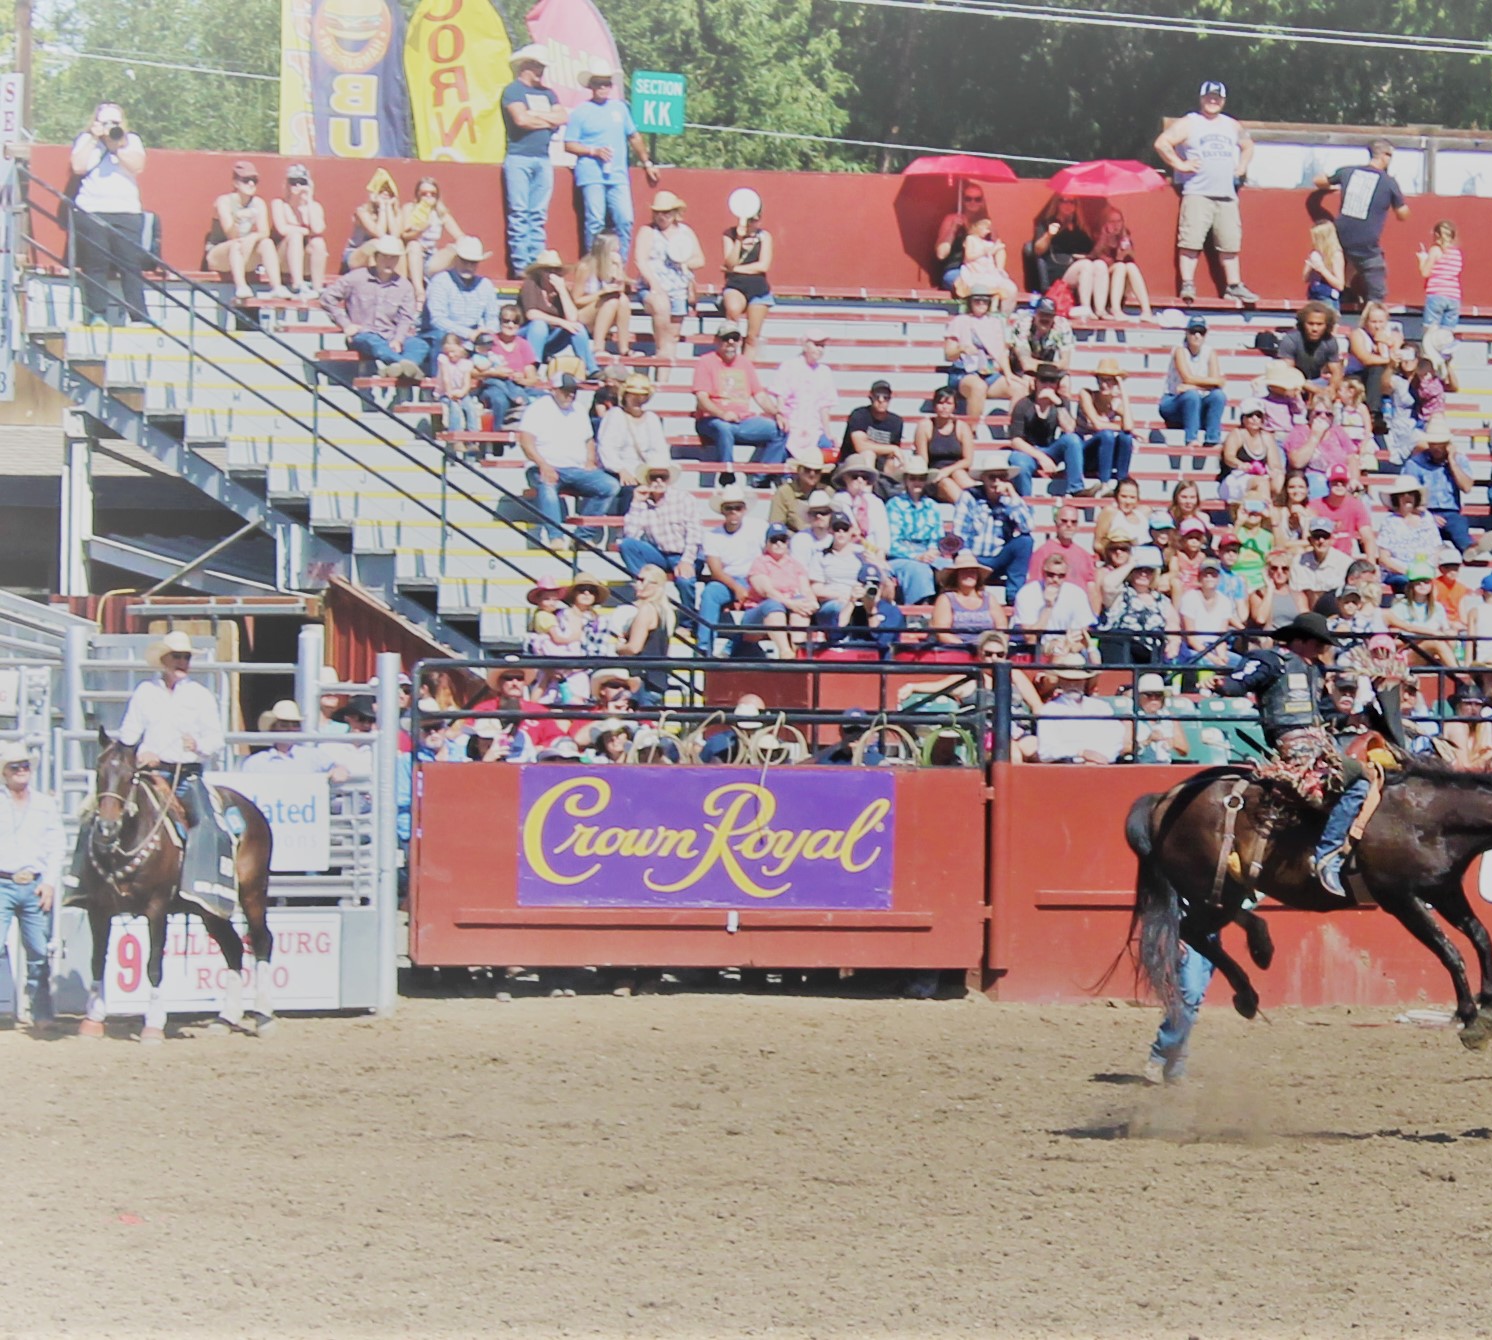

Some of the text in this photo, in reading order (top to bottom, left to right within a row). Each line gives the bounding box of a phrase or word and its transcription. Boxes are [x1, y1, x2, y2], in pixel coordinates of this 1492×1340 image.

[636, 79, 683, 96] SECTION
[643, 100, 672, 126] KK
[523, 776, 891, 898] Crown Royal
[117, 934, 142, 993] 9
